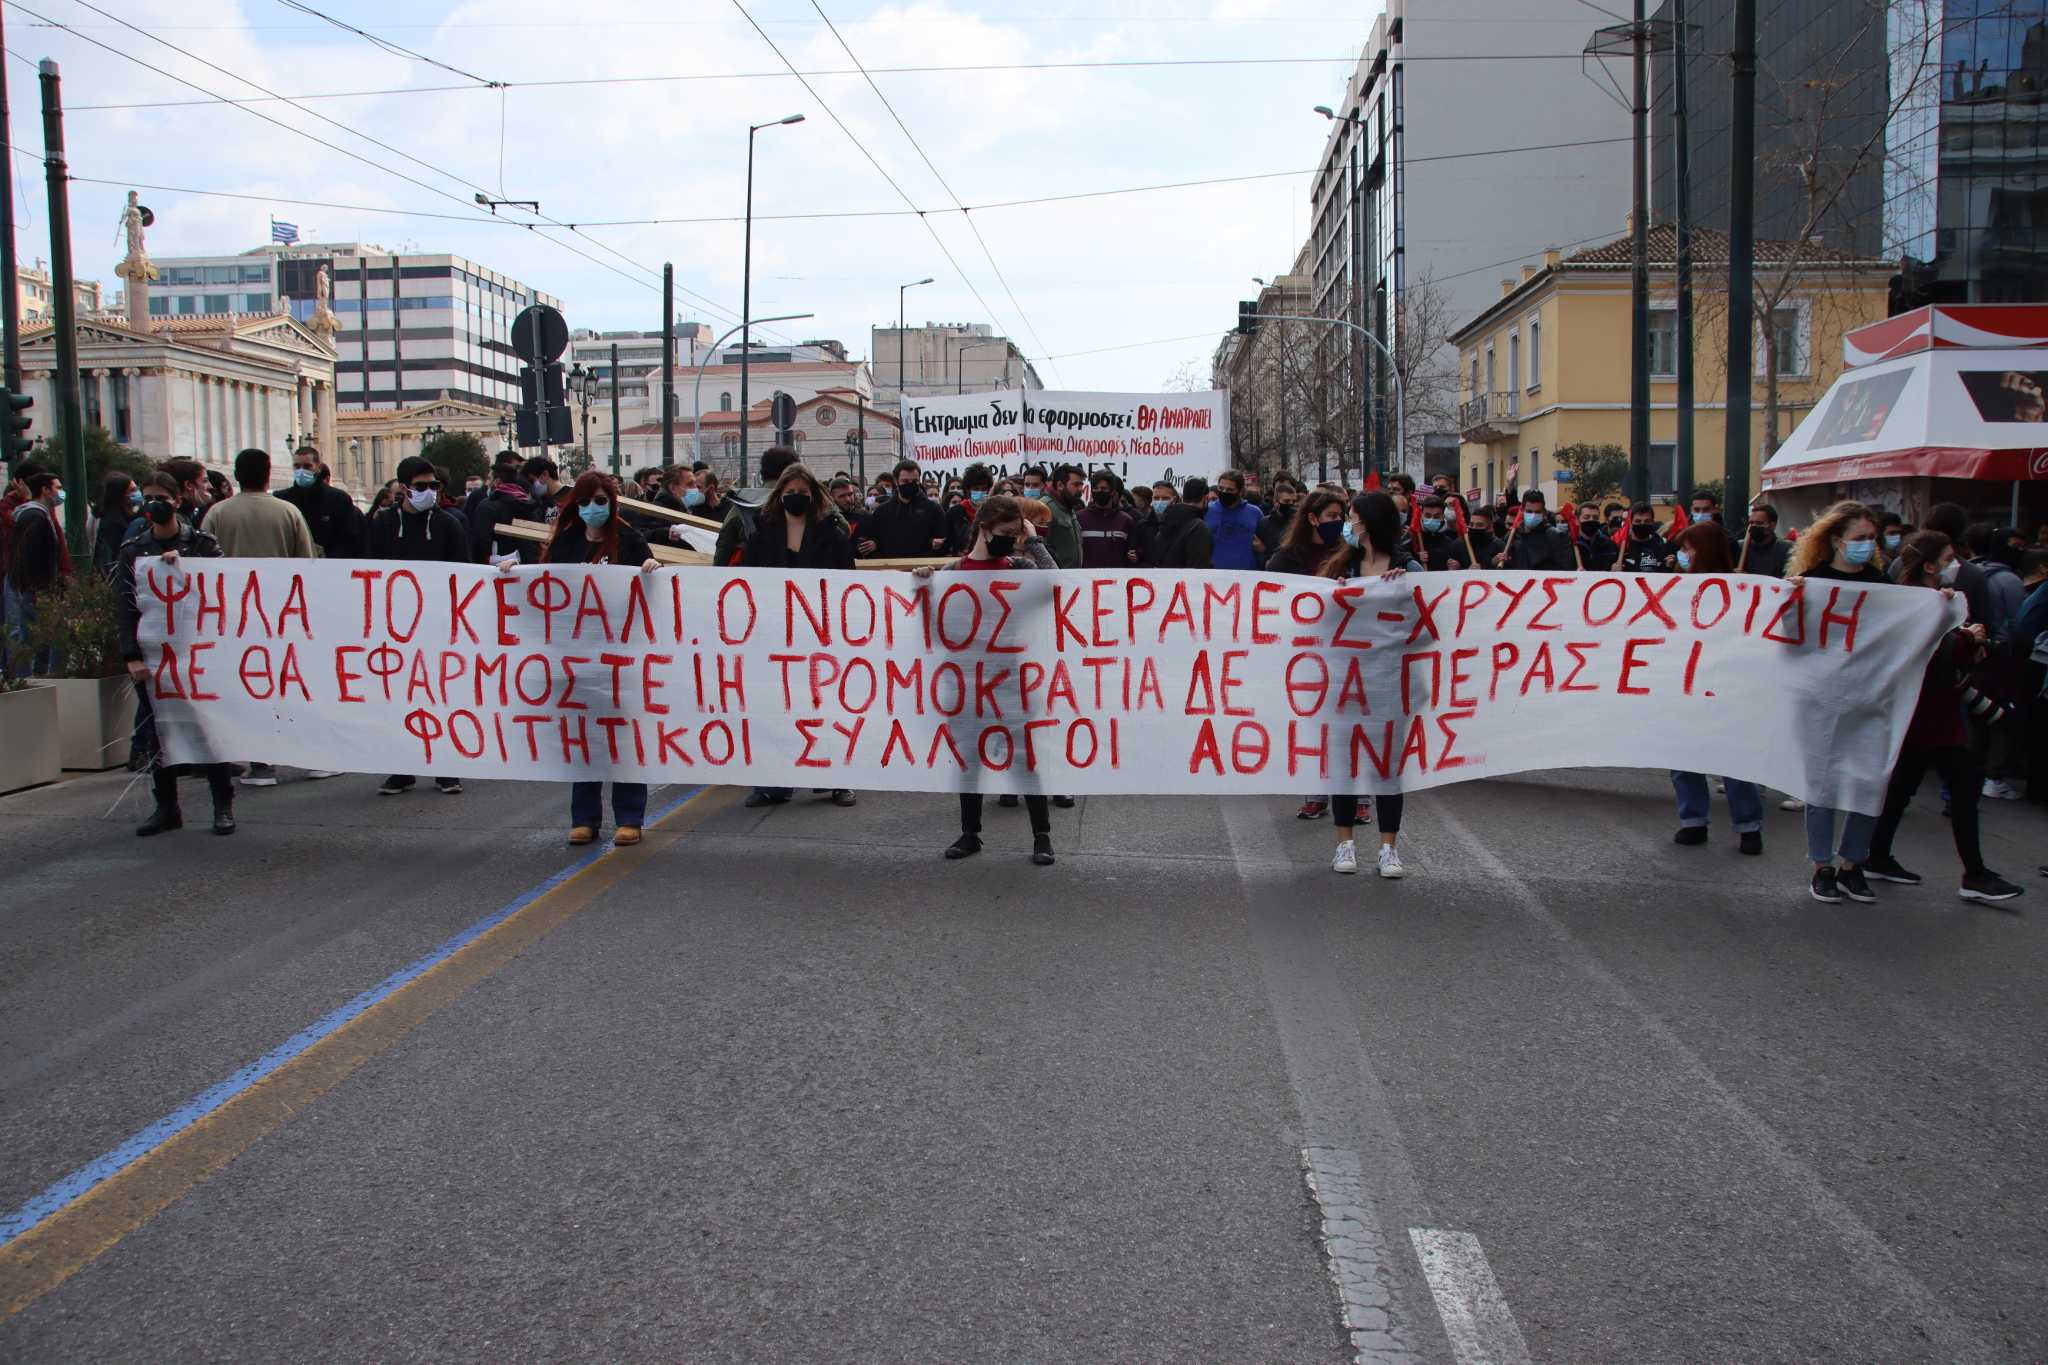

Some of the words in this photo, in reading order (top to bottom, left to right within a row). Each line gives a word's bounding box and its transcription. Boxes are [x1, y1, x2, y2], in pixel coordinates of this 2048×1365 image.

[990, 400, 1018, 427] δεν
[148, 569, 314, 640] ΨΗΛΑ
[352, 569, 424, 644] ΤΟ
[717, 578, 757, 646] Ο
[784, 579, 1026, 654] ΝΟΜΟΣ
[154, 642, 219, 701] ΔΕ
[239, 643, 312, 702] ΘΑ
[768, 652, 1165, 719] ΤΡΟΜΟΚΡΑΤΙΑ
[1184, 650, 1256, 718] ΔΕ
[1285, 652, 1370, 718] ΘΑ
[404, 707, 753, 767] ΦΟΙΤΗΤΙΚΟΙ
[795, 716, 1120, 773] ΣΥΛΛΟΓΟΙ
[1189, 709, 1486, 779] ΑΘΗΝΑΣ
